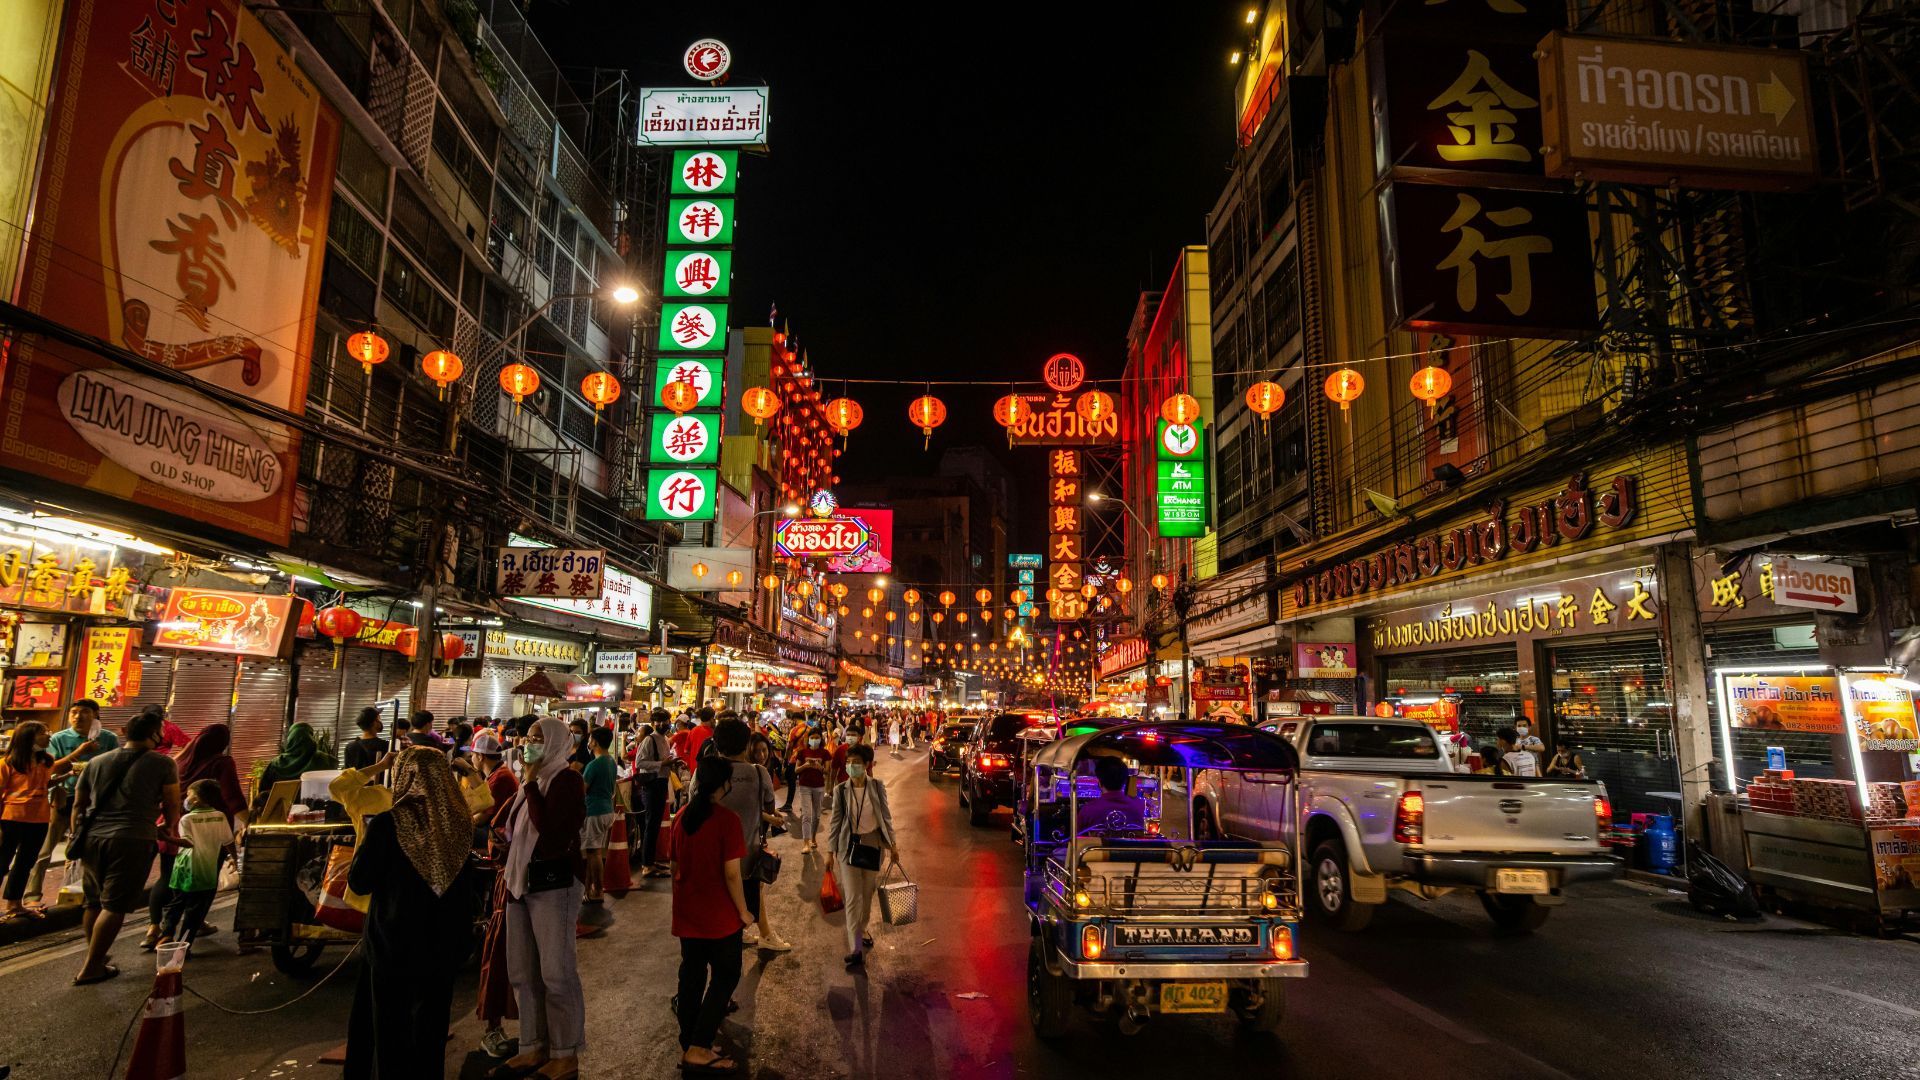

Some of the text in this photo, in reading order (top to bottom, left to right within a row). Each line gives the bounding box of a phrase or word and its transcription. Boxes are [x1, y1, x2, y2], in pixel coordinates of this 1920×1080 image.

[1577, 46, 1751, 116] ที่จอดรถ
[677, 93, 731, 103] ห้างขายยา
[71, 375, 276, 493] LIM JING HIENG
[150, 460, 216, 493] OLD SHOP
[1172, 480, 1192, 490] ATM
[786, 524, 859, 551] ทองใบ
[1776, 561, 1852, 595] ที่จอดรถ
[89, 652, 115, 698] 林真香
[1124, 927, 1252, 943] THAILAND
